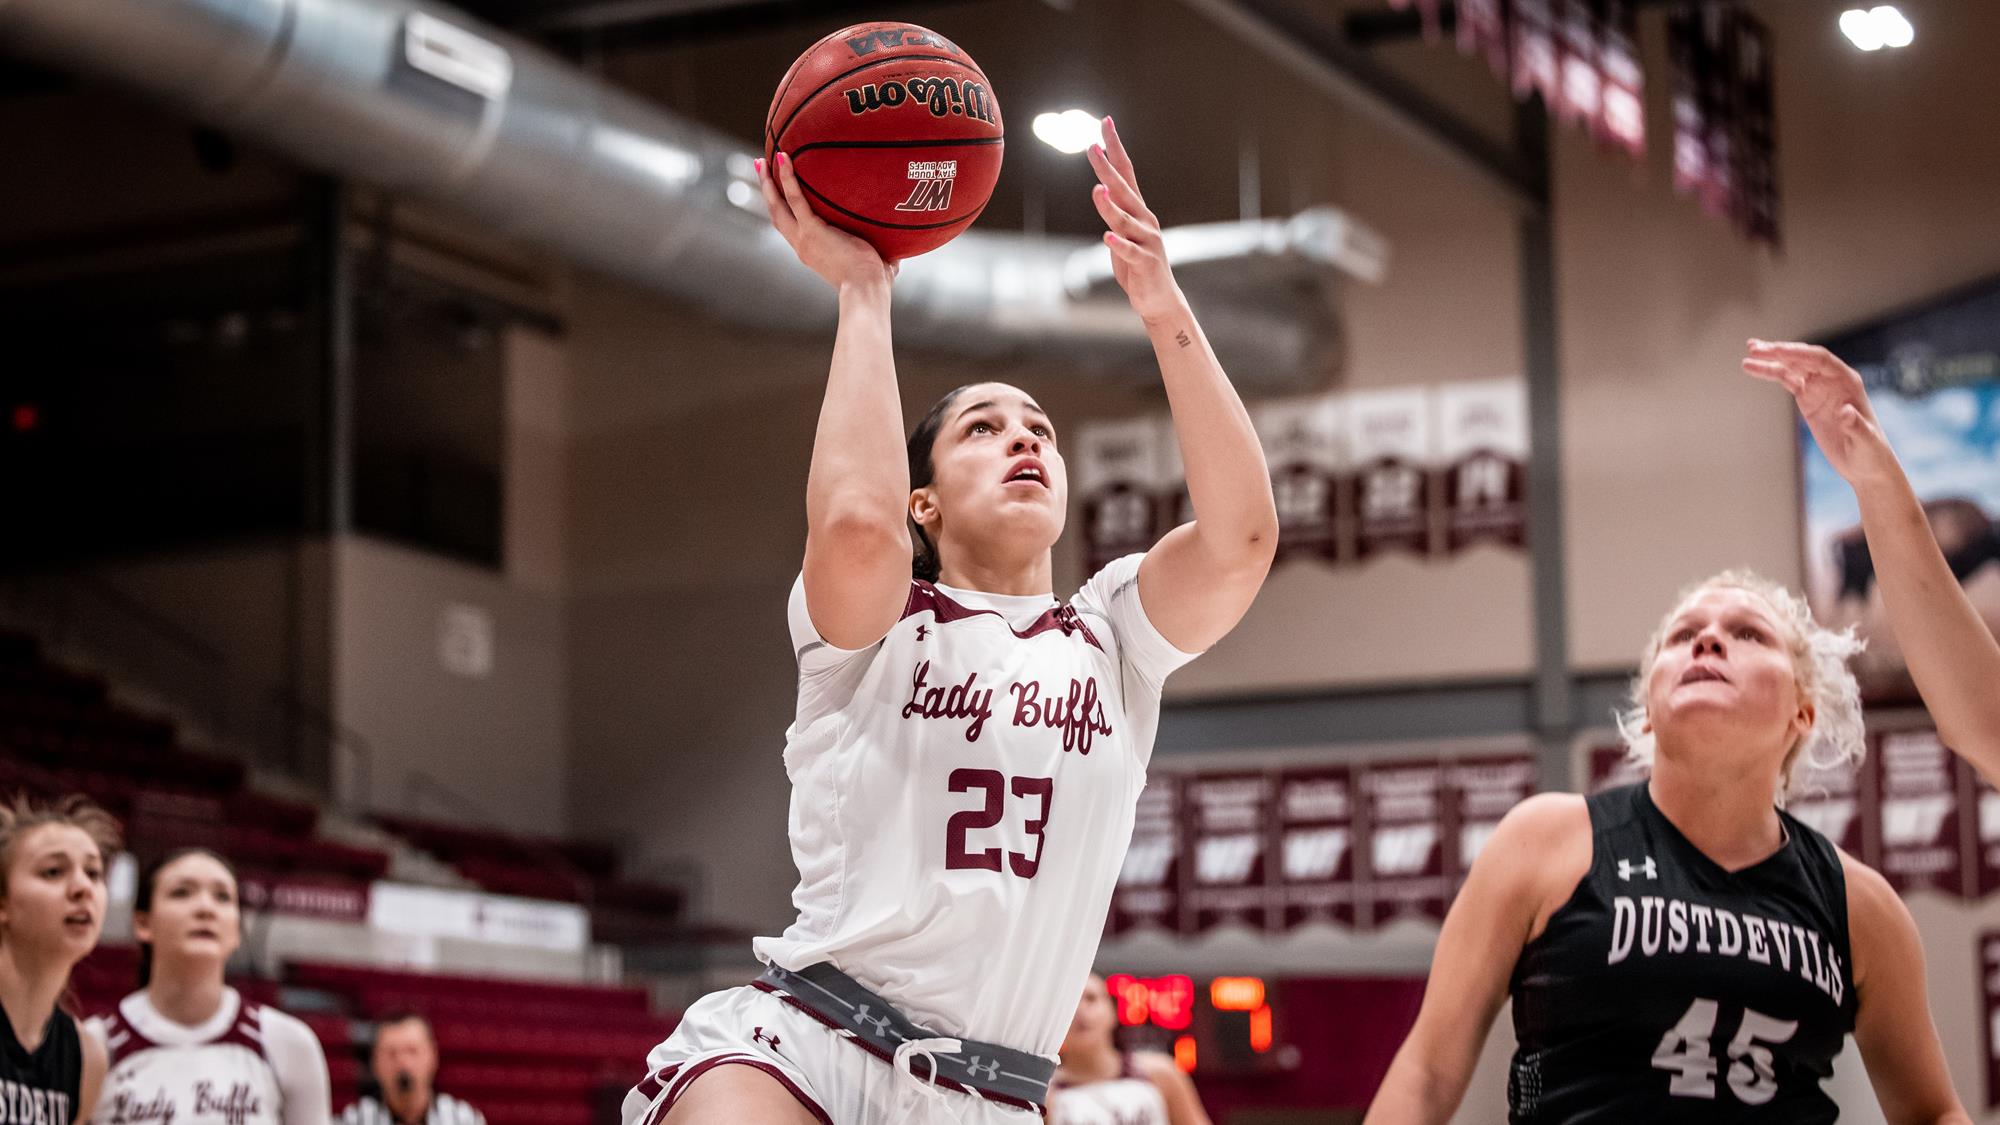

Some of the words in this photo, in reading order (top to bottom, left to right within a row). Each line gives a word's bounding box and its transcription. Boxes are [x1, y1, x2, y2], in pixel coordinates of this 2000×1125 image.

[845, 77, 995, 126] Wilson
[908, 161, 936, 171] BUFFS
[908, 170, 936, 179] TOUGH
[937, 160, 957, 171] LADY
[937, 169, 956, 179] STAY
[895, 179, 953, 211] WT
[902, 660, 993, 742] Lady
[1010, 677, 1112, 755] Buffs
[946, 768, 1053, 879] 23
[1608, 896, 1844, 1007] DUSTDEVILS
[1651, 998, 1798, 1106] 45
